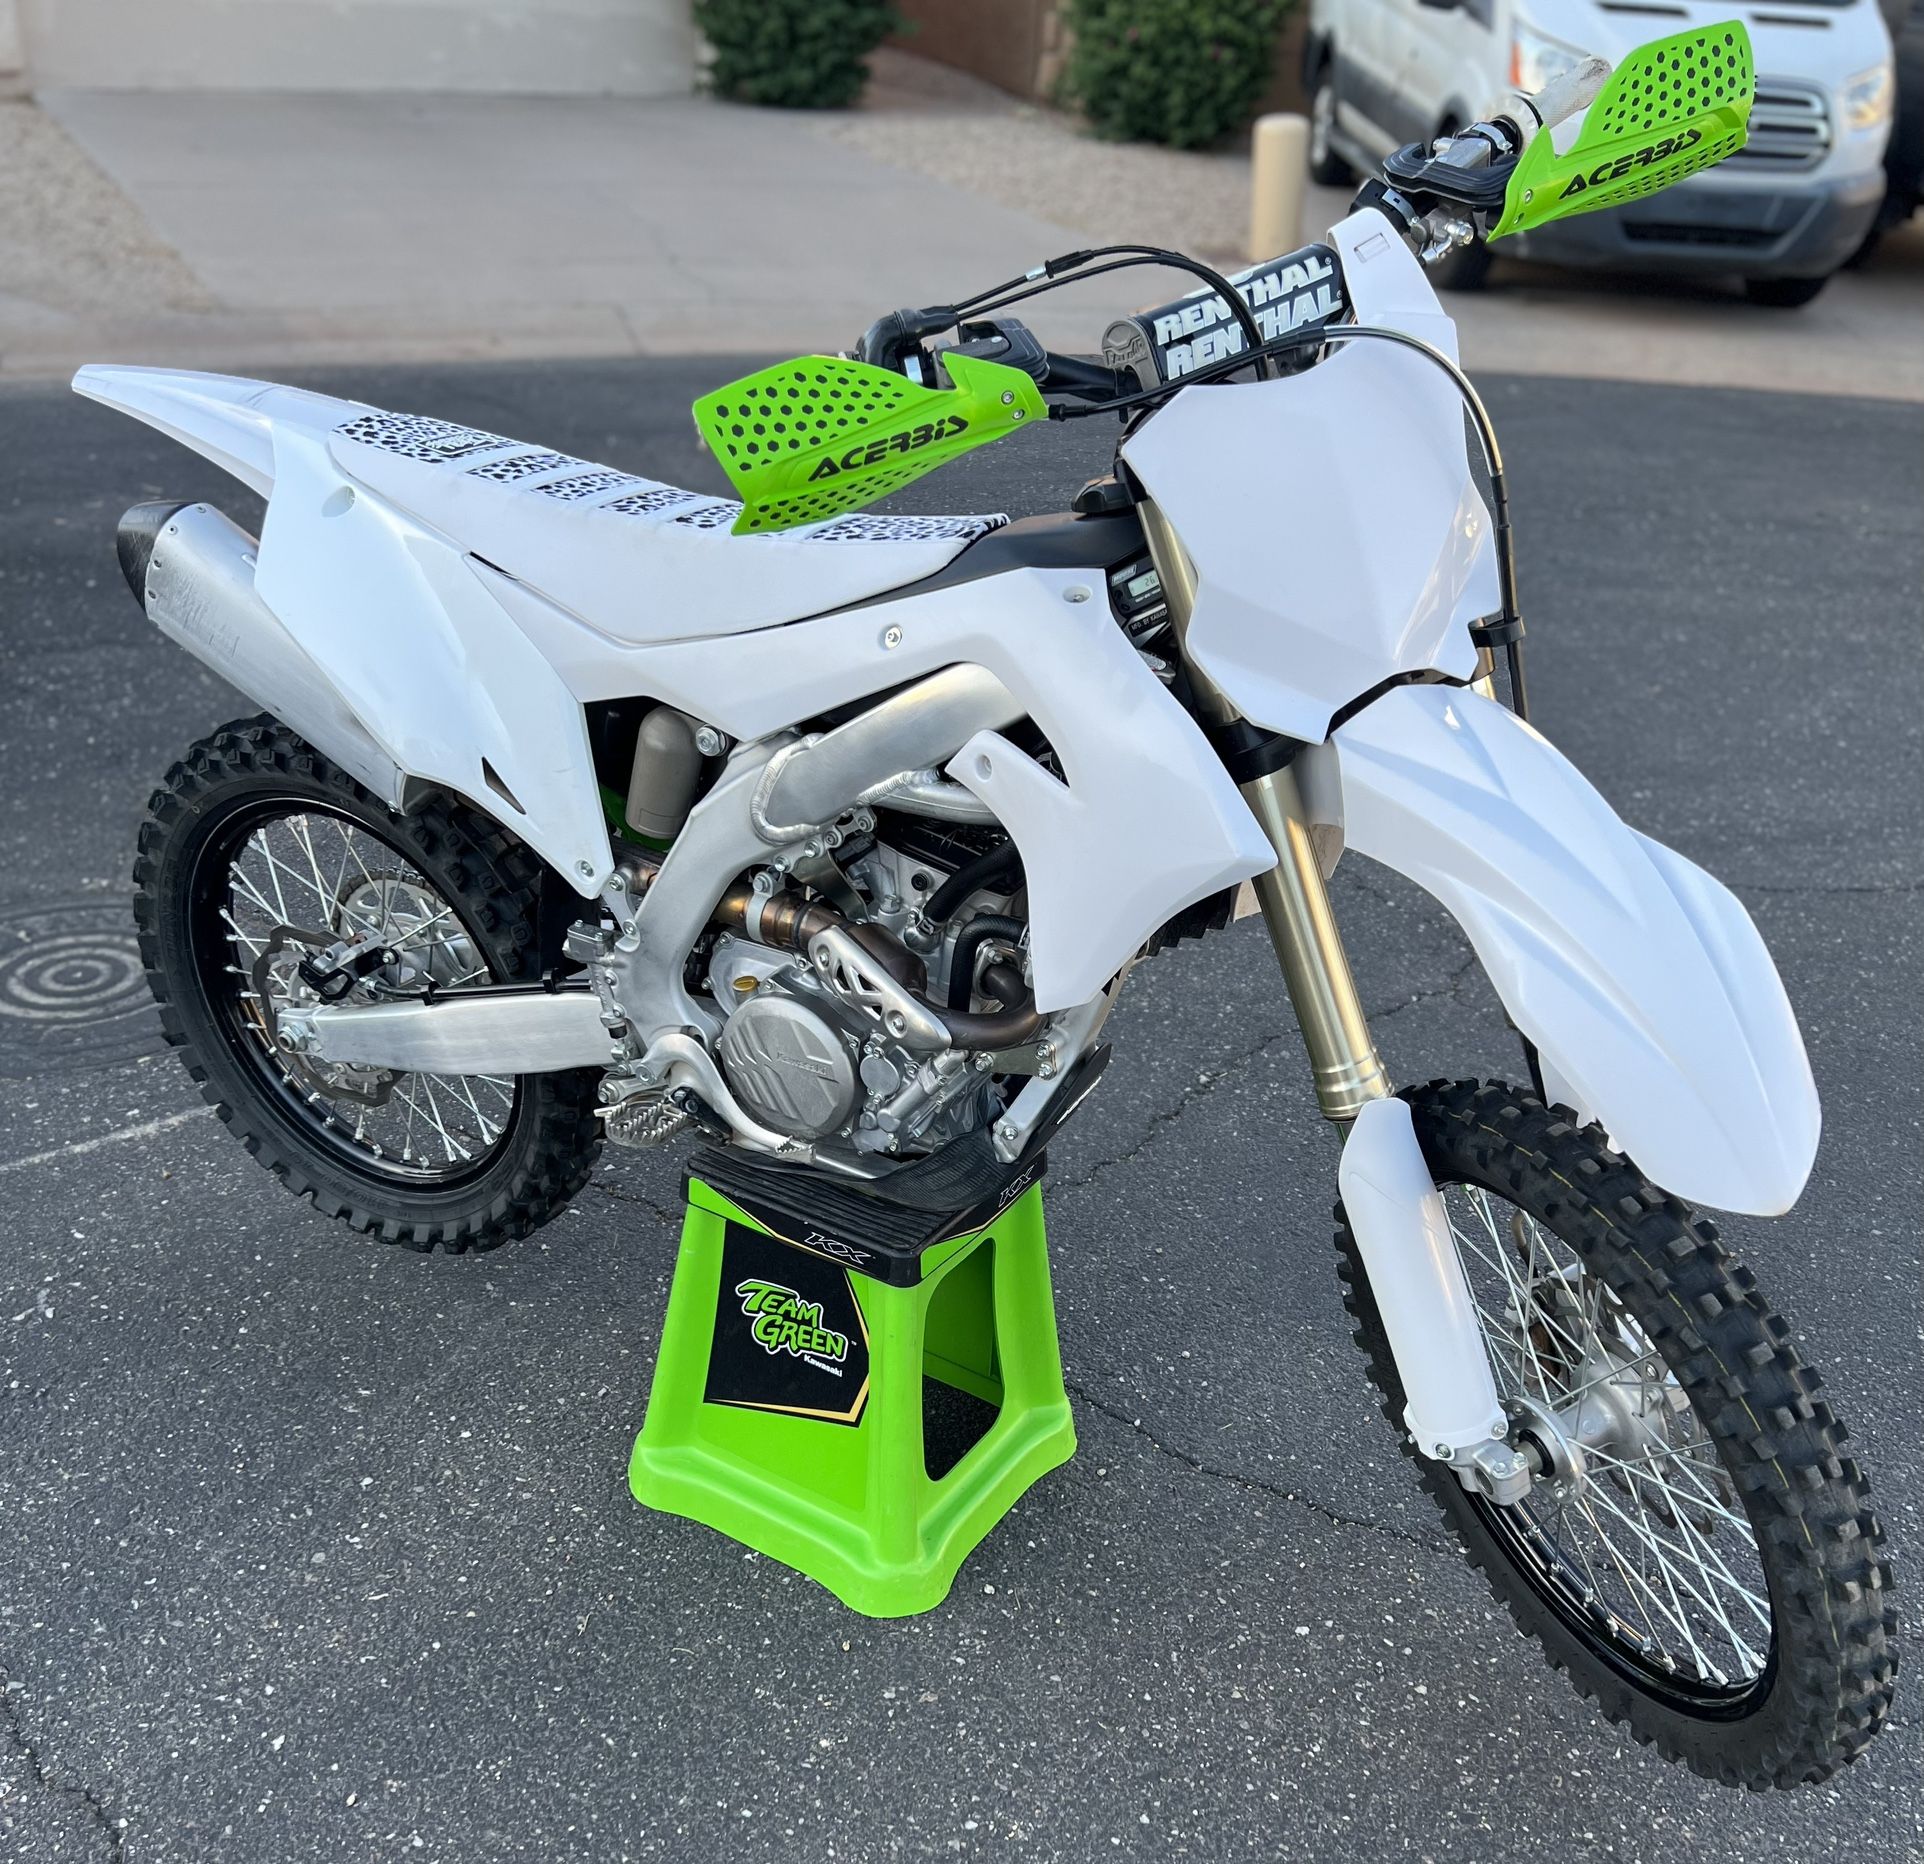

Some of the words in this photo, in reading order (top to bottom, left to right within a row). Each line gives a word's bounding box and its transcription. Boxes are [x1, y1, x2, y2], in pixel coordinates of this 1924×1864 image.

[998, 1164, 1035, 1208] KX
[803, 1231, 872, 1265] KX
[737, 1281, 821, 1329] TEAM
[754, 1313, 846, 1358] GREEN
[803, 1354, 843, 1378] Kawasaki
